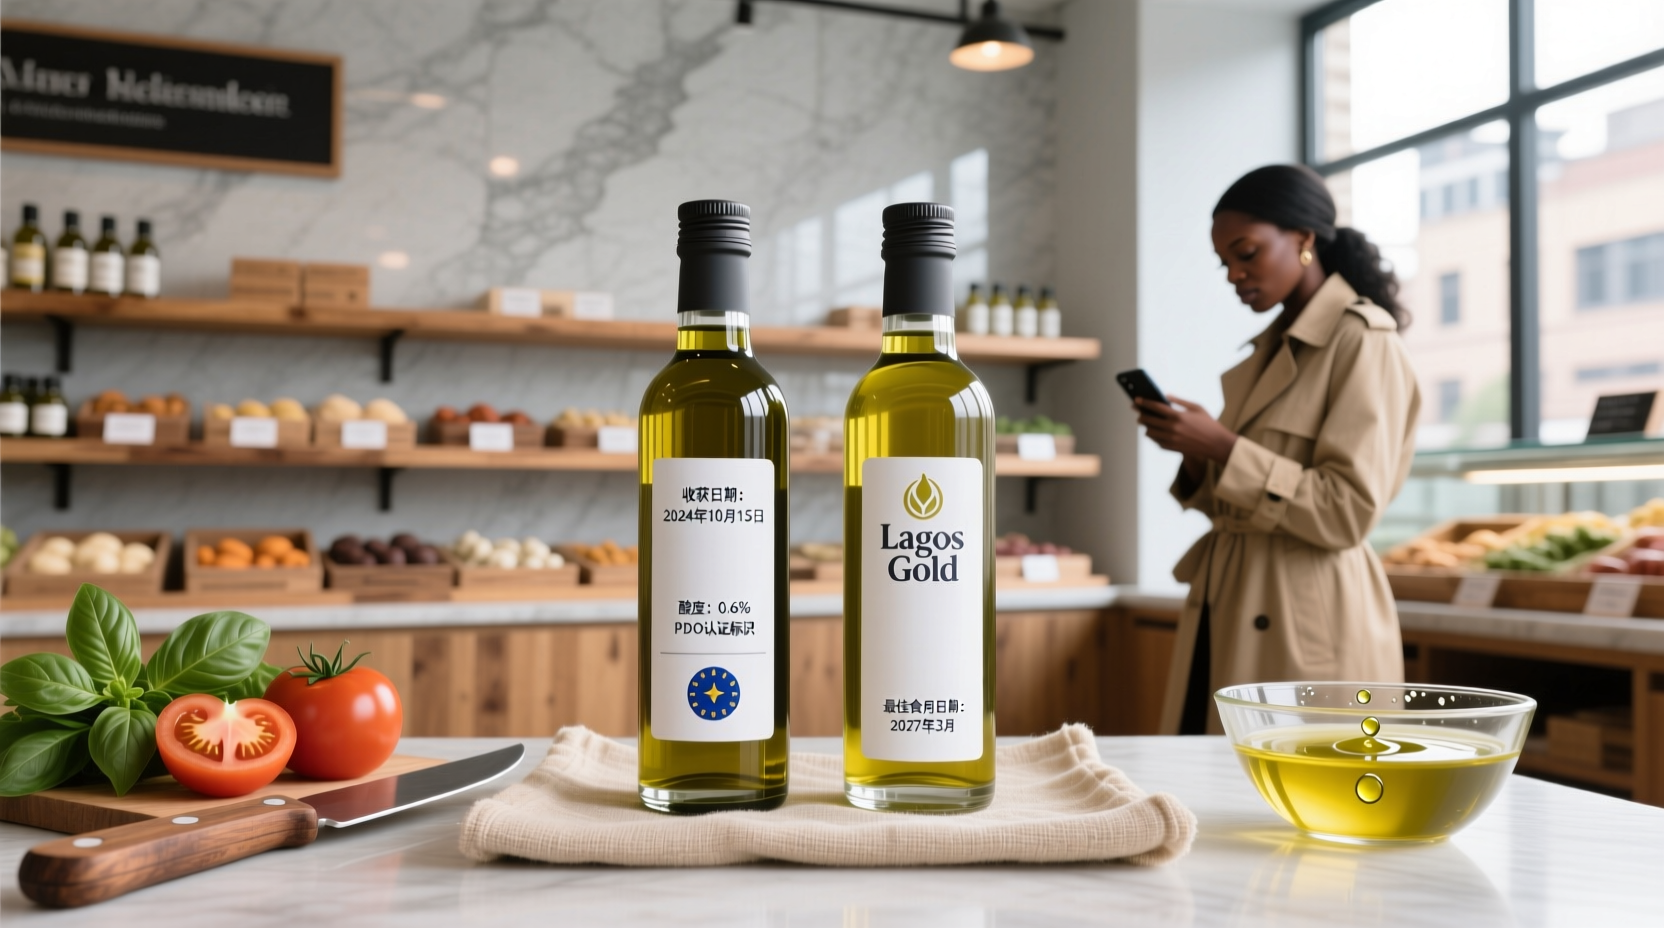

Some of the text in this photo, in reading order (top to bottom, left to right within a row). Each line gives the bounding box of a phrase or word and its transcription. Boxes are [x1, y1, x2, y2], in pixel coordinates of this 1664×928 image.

[663, 507, 764, 524] 2024年10月15日
[880, 523, 964, 558] Lagos
[888, 554, 959, 582] Gold
[890, 718, 954, 734] 2027年3月
